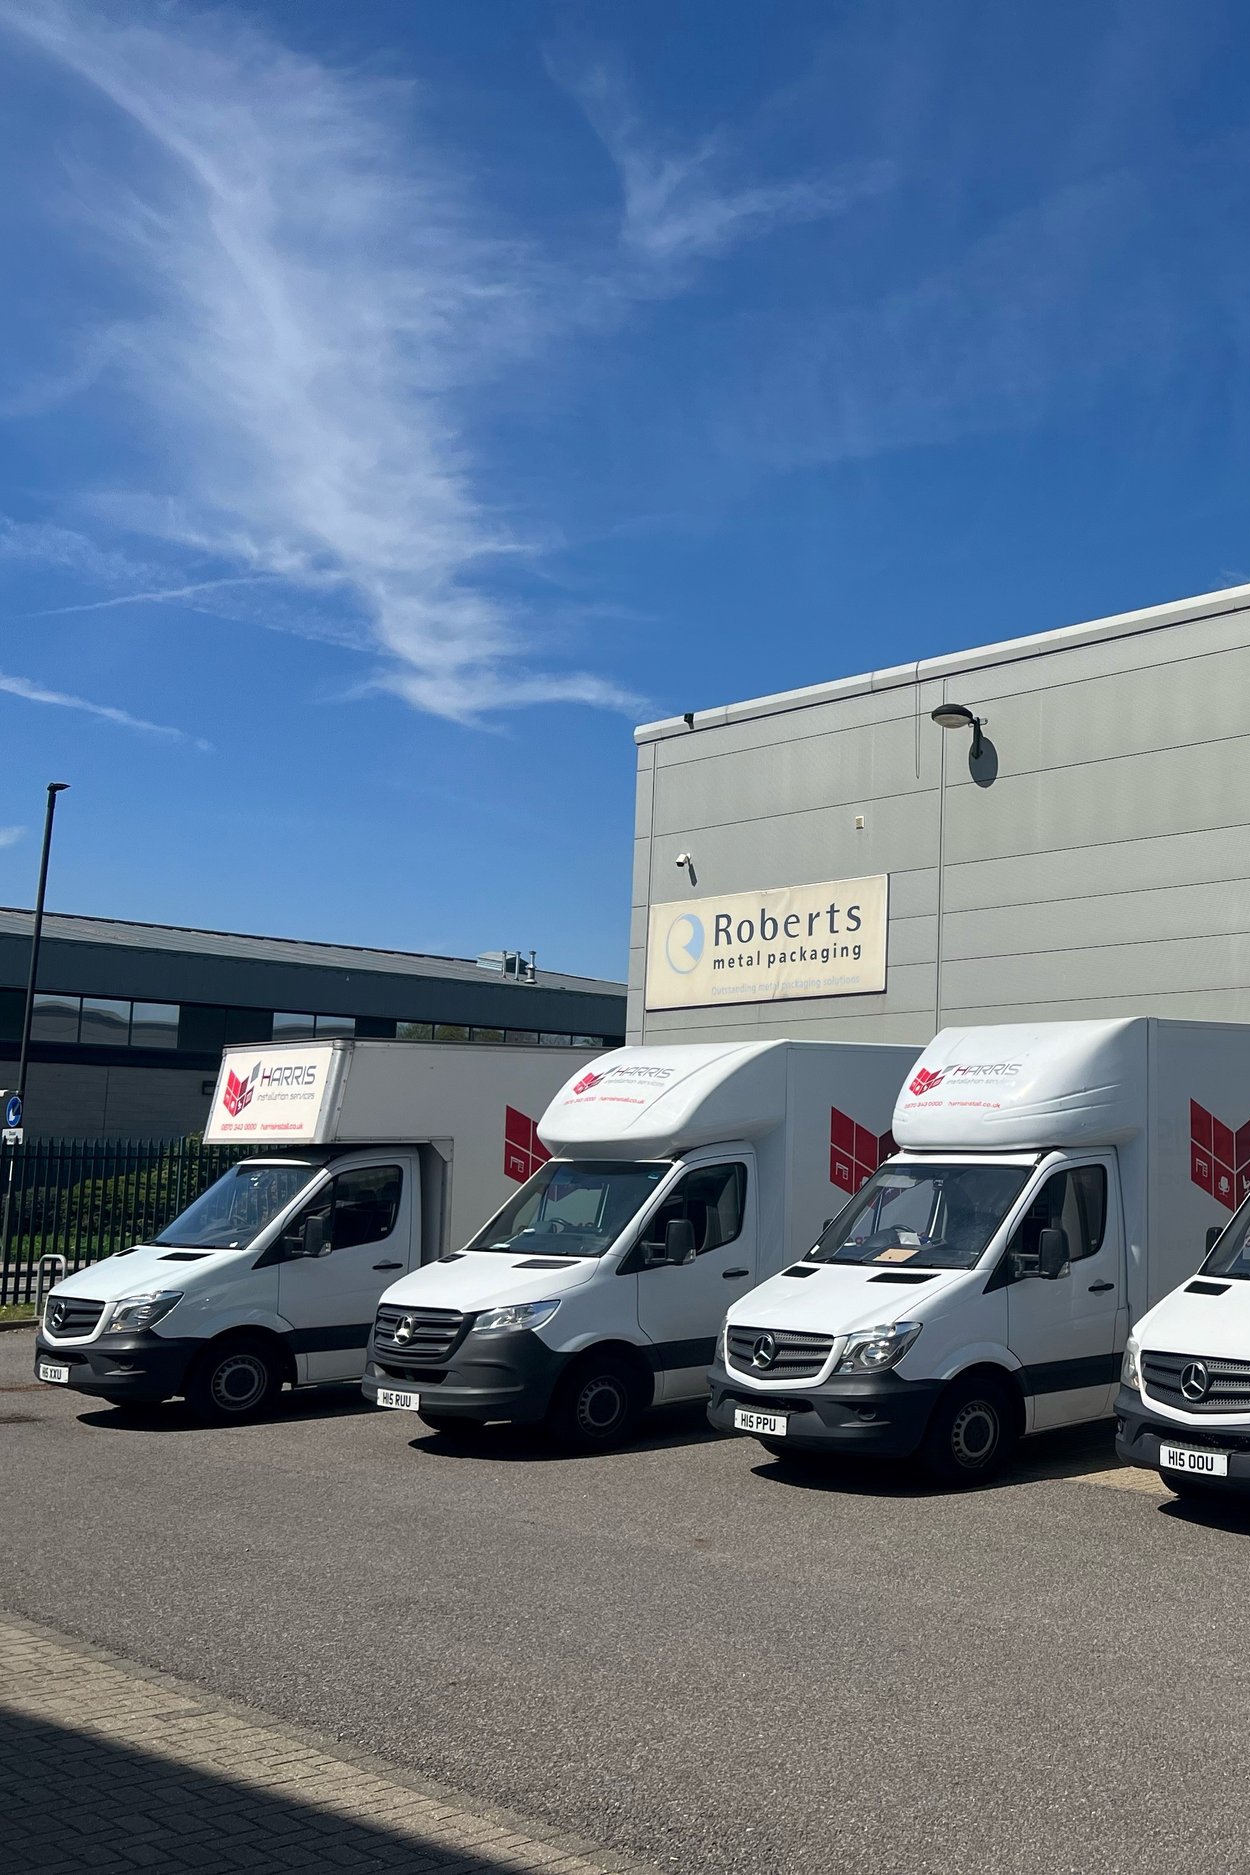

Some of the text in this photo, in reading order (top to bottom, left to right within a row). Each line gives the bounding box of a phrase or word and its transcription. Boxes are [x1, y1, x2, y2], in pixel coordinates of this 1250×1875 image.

[714, 902, 862, 946] Roberts
[713, 943, 862, 970] metal packaging
[758, 981, 780, 991] metal
[782, 978, 821, 990] packaging
[823, 976, 860, 986] solutions
[260, 1065, 317, 1087] HARRIS
[612, 1066, 675, 1079] HARRIS
[953, 1064, 1022, 1076] HARRIS
[290, 1092, 315, 1100] services
[395, 1393, 411, 1407] RUU
[756, 1416, 776, 1432] PPU
[1189, 1454, 1214, 1471] OOU
